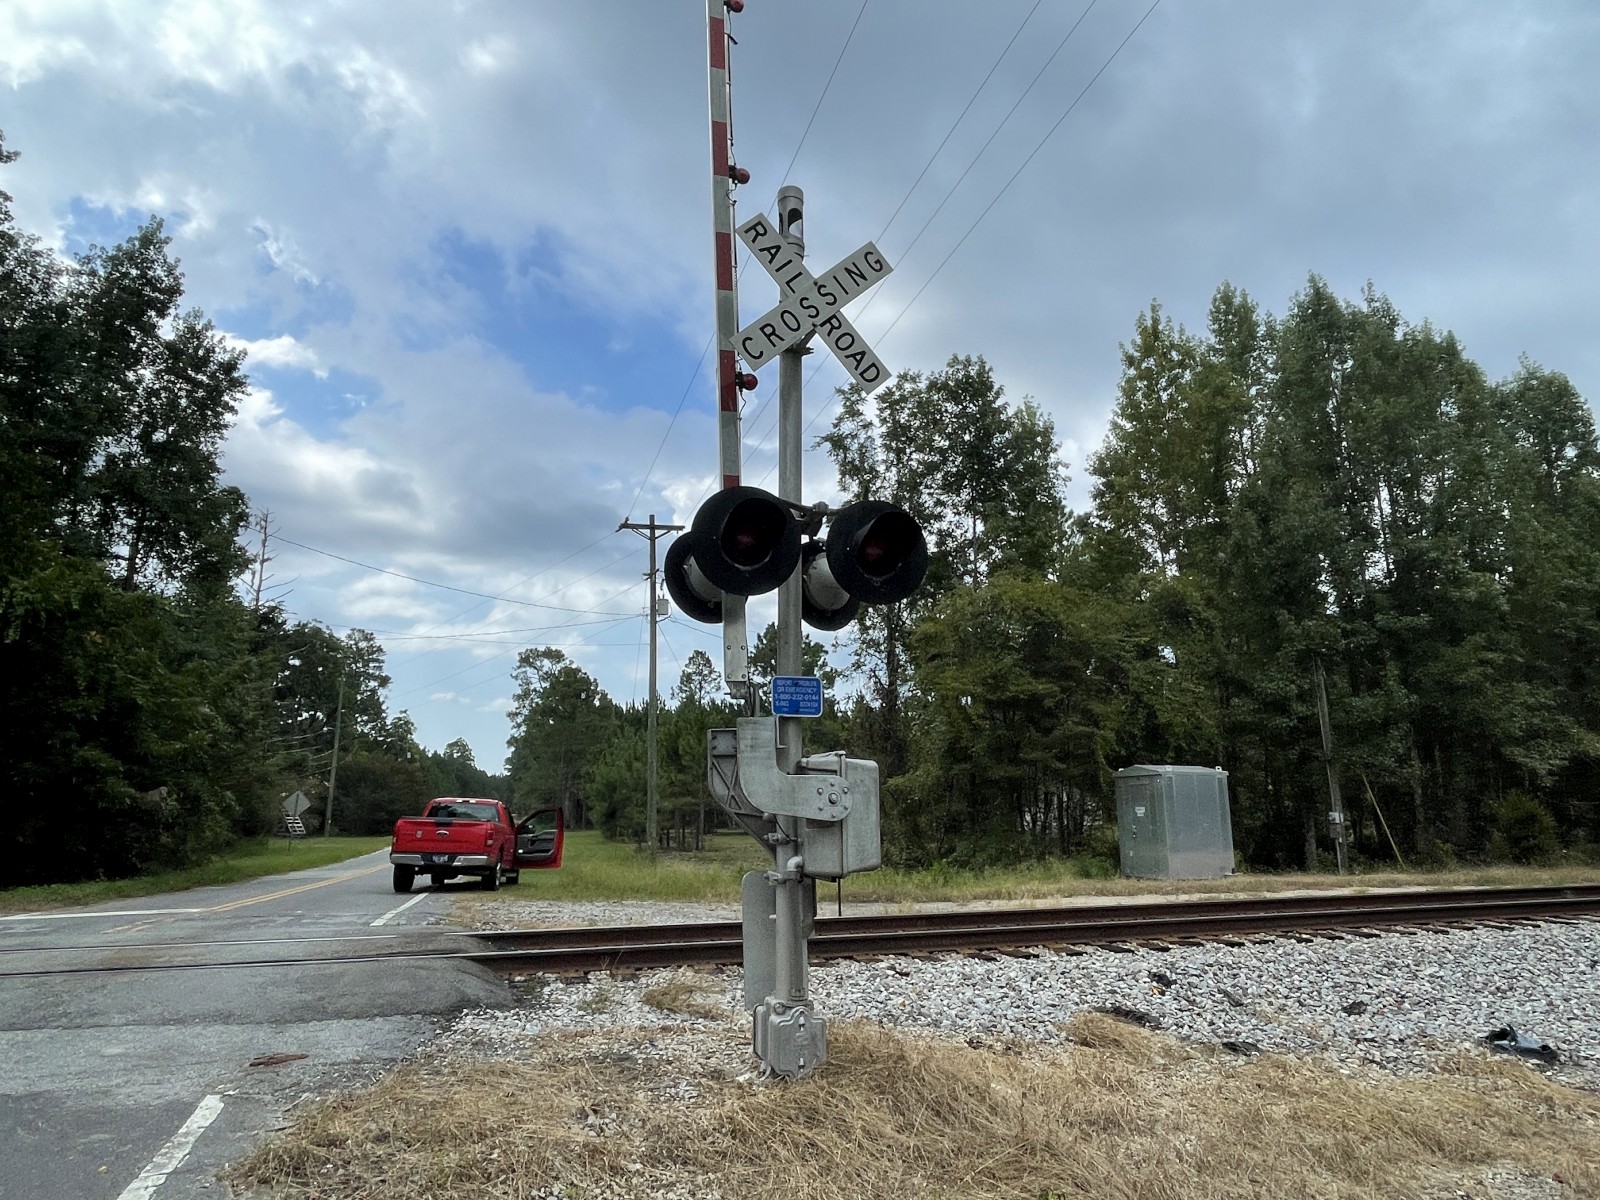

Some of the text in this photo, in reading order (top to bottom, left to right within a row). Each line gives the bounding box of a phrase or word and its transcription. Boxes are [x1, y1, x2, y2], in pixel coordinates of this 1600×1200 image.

[742, 251, 884, 360] CROSSING
[744, 221, 880, 383] RAIL ROAD
